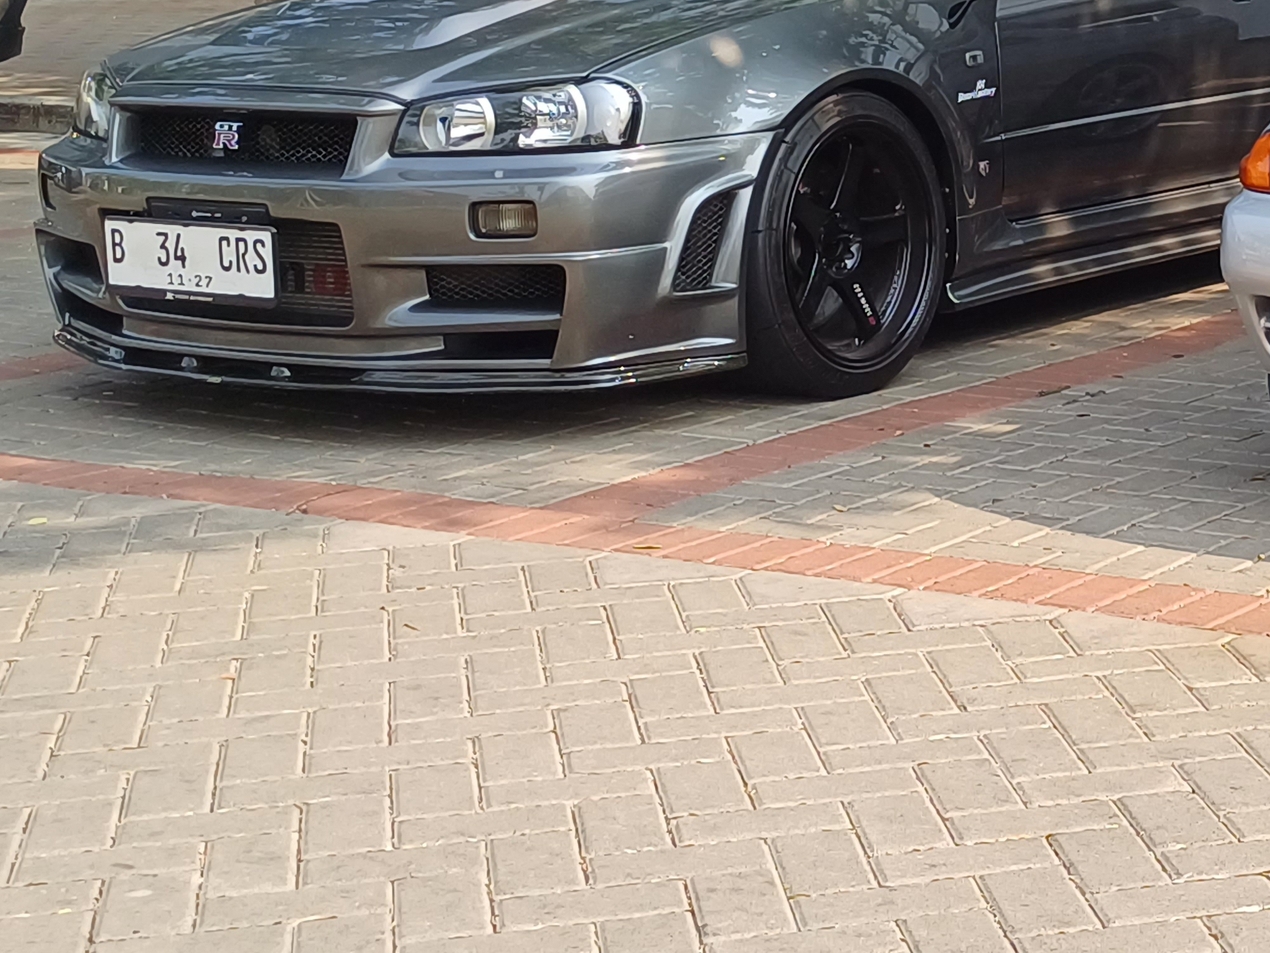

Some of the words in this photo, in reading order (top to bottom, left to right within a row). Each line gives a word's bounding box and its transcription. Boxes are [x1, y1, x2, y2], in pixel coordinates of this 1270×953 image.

[215, 121, 243, 131] GT
[213, 131, 239, 150] R
[111, 228, 126, 264] B
[155, 231, 187, 269] 34
[218, 236, 267, 275] CRS
